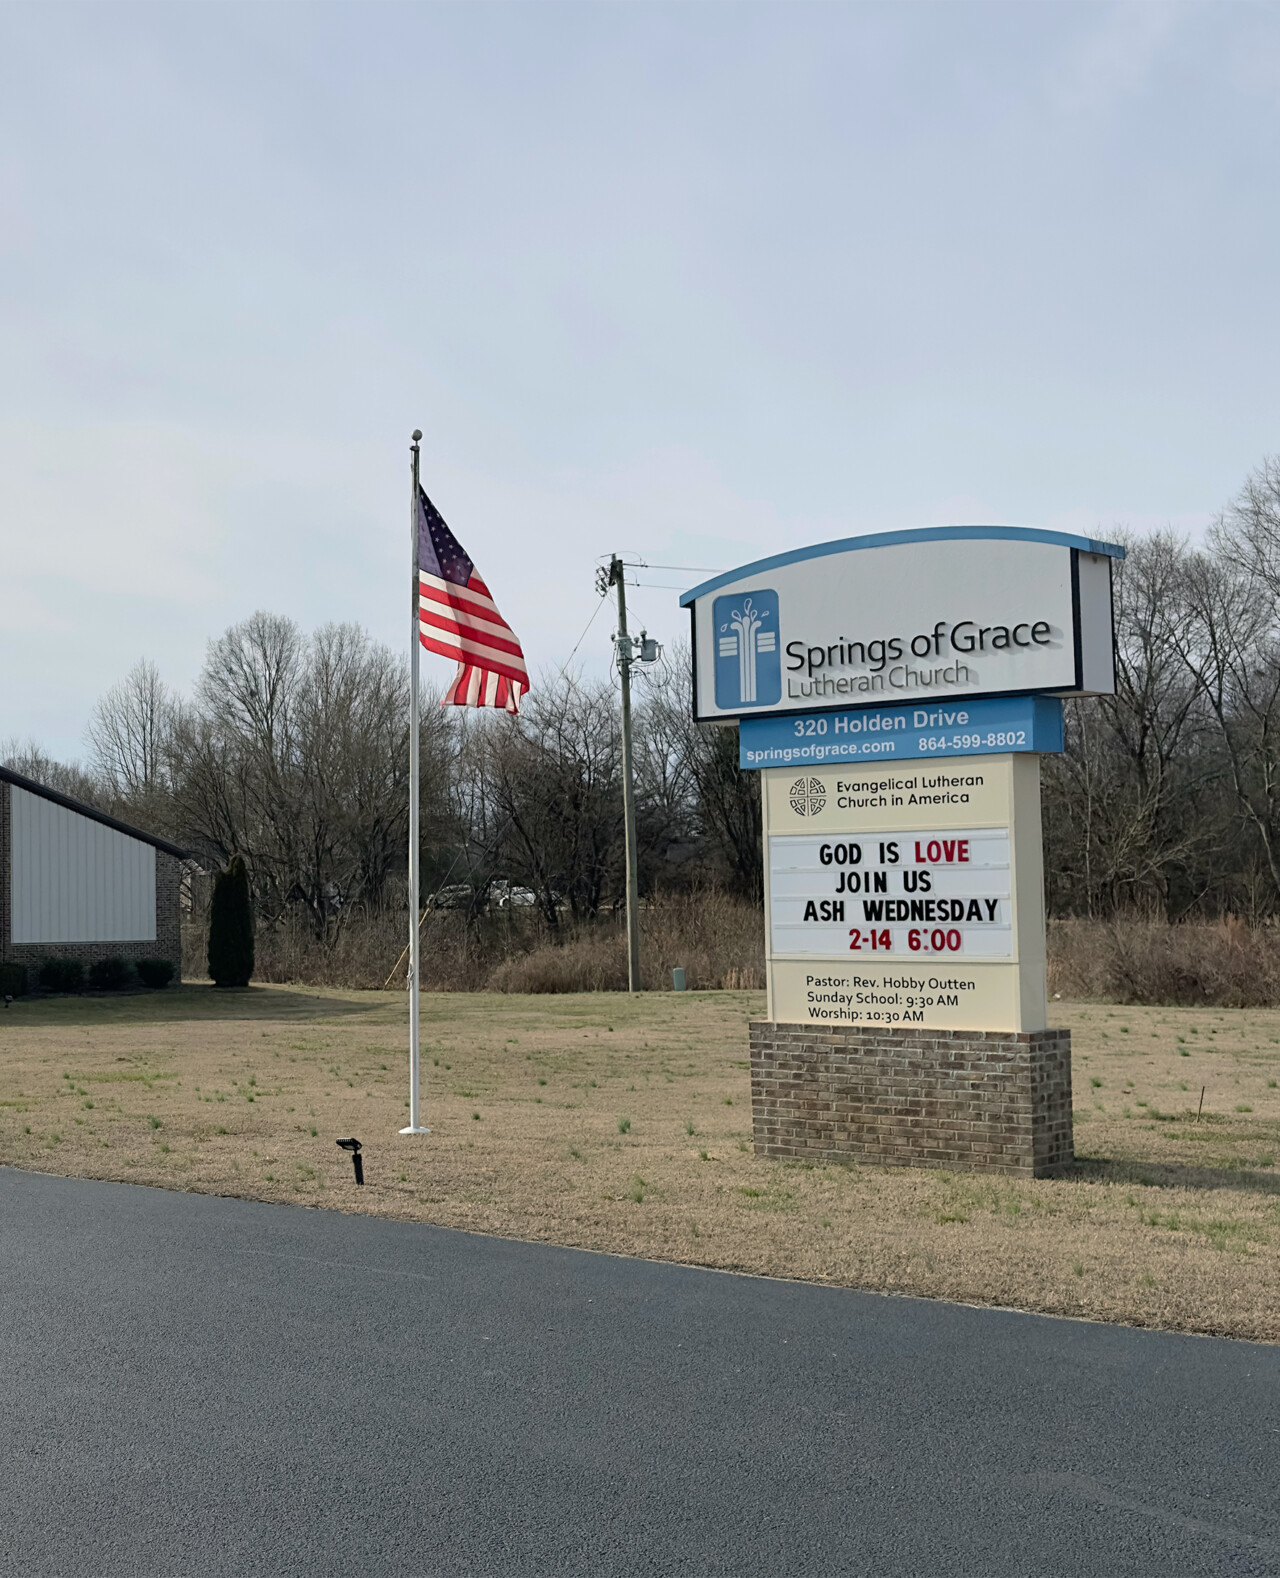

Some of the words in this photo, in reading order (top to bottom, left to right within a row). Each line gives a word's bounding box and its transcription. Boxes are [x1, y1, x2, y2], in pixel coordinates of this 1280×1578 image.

[786, 637, 903, 677] Springs
[911, 622, 946, 657] of
[950, 620, 1051, 653] Grace
[787, 673, 884, 698] Lutheran
[889, 660, 969, 689] Church
[794, 718, 828, 737] 320
[835, 715, 906, 734] Holden
[913, 709, 969, 728] Drive
[746, 741, 895, 762] springsofgrace.com
[918, 731, 1026, 751] 864-599-8802
[837, 777, 917, 793] Evangelical
[922, 775, 984, 788] Lutheran
[837, 795, 887, 808] Church
[891, 795, 903, 806] in
[906, 792, 970, 805] America
[819, 843, 862, 865] GOD
[879, 842, 899, 864] IS
[915, 840, 970, 863] LOVE
[835, 871, 887, 893] JOIN
[903, 870, 931, 892] US
[803, 900, 844, 921] ASH
[862, 898, 999, 921] WEDNESDAY
[849, 928, 892, 950] 2-14
[908, 928, 961, 951] 6:00
[806, 975, 850, 987] Pastor:
[853, 976, 879, 988] Rev.
[883, 977, 925, 992] Hobby
[928, 978, 975, 990] Outten
[807, 991, 853, 1006] Sunday
[856, 992, 903, 1005] School:
[906, 996, 934, 1008] 9:30
[936, 995, 959, 1006] AM
[808, 1007, 862, 1022] Worship:
[866, 1011, 900, 1023] 10:30
[902, 1010, 924, 1022] AM
